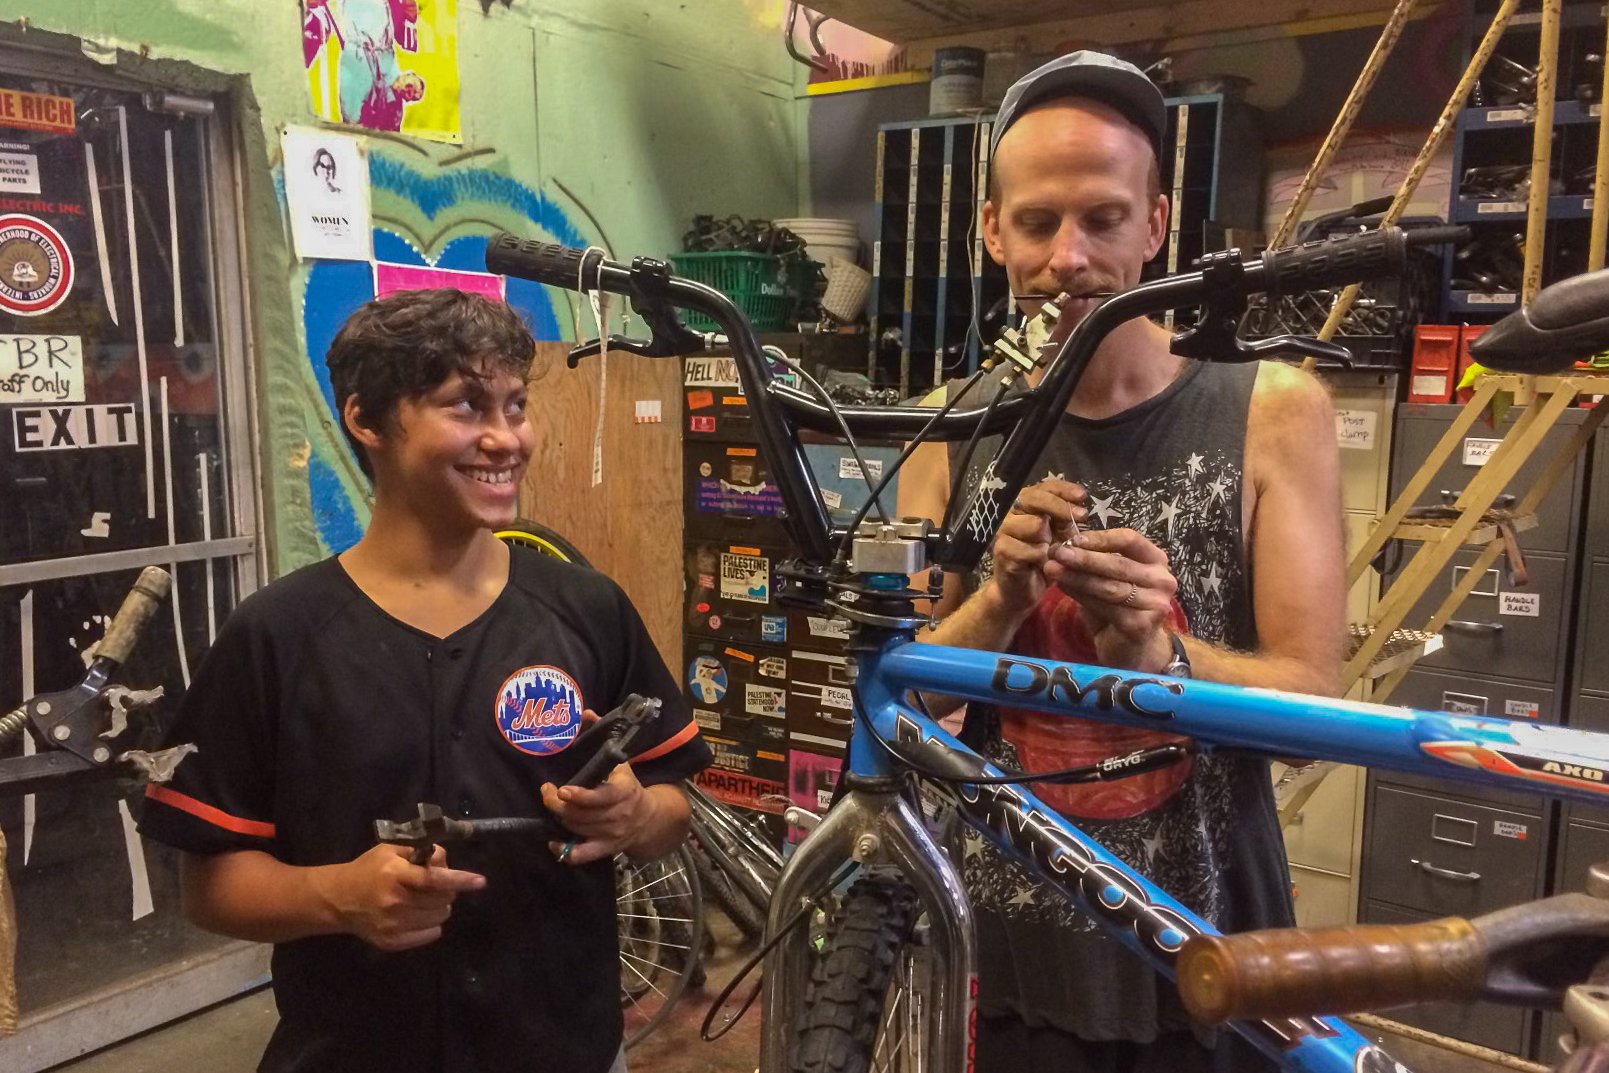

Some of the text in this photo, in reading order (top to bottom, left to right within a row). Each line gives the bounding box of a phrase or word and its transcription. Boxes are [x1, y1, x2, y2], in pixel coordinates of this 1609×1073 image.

[21, 95, 73, 125] RICH
[0, 142, 30, 151] ARNING!
[2, 176, 27, 184] PARTS
[0, 199, 54, 212] LECTRIC
[311, 215, 349, 225] WOMEN
[30, 232, 41, 242] OF
[685, 362, 713, 382] HELL
[32, 371, 71, 399] Only
[15, 406, 133, 448] EXIT
[723, 554, 767, 572] PALESTINE
[723, 566, 746, 580] LIVES
[747, 691, 773, 699] PALESTINE
[828, 689, 851, 701] PEDAL
[990, 657, 1185, 719] DMC
[511, 697, 571, 730] Mets
[1542, 761, 1604, 781] AXO
